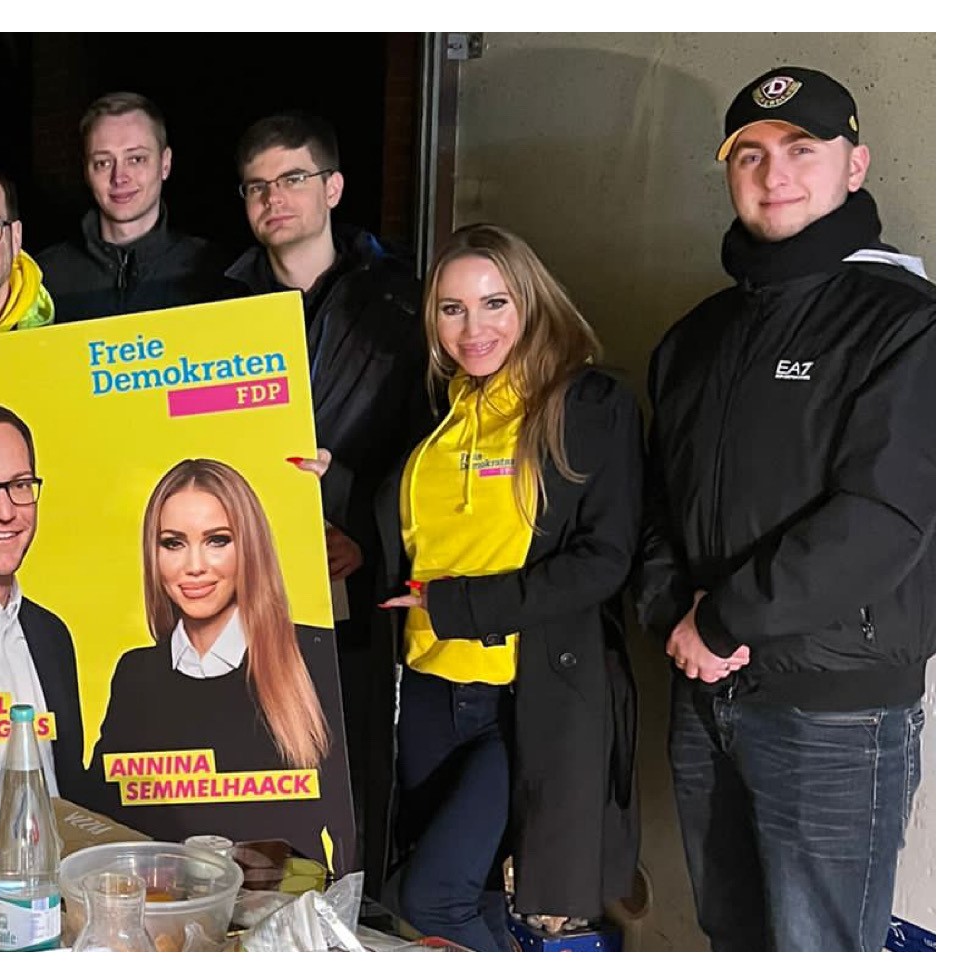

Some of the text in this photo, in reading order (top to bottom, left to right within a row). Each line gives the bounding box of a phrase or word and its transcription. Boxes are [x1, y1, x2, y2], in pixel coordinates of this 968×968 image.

[88, 335, 164, 366] Freie
[91, 351, 286, 394] Demokraten
[776, 360, 814, 375] EA7
[235, 382, 281, 404] FDP
[109, 754, 210, 777] ANNINA
[125, 774, 312, 800] SEMMELHAACK
